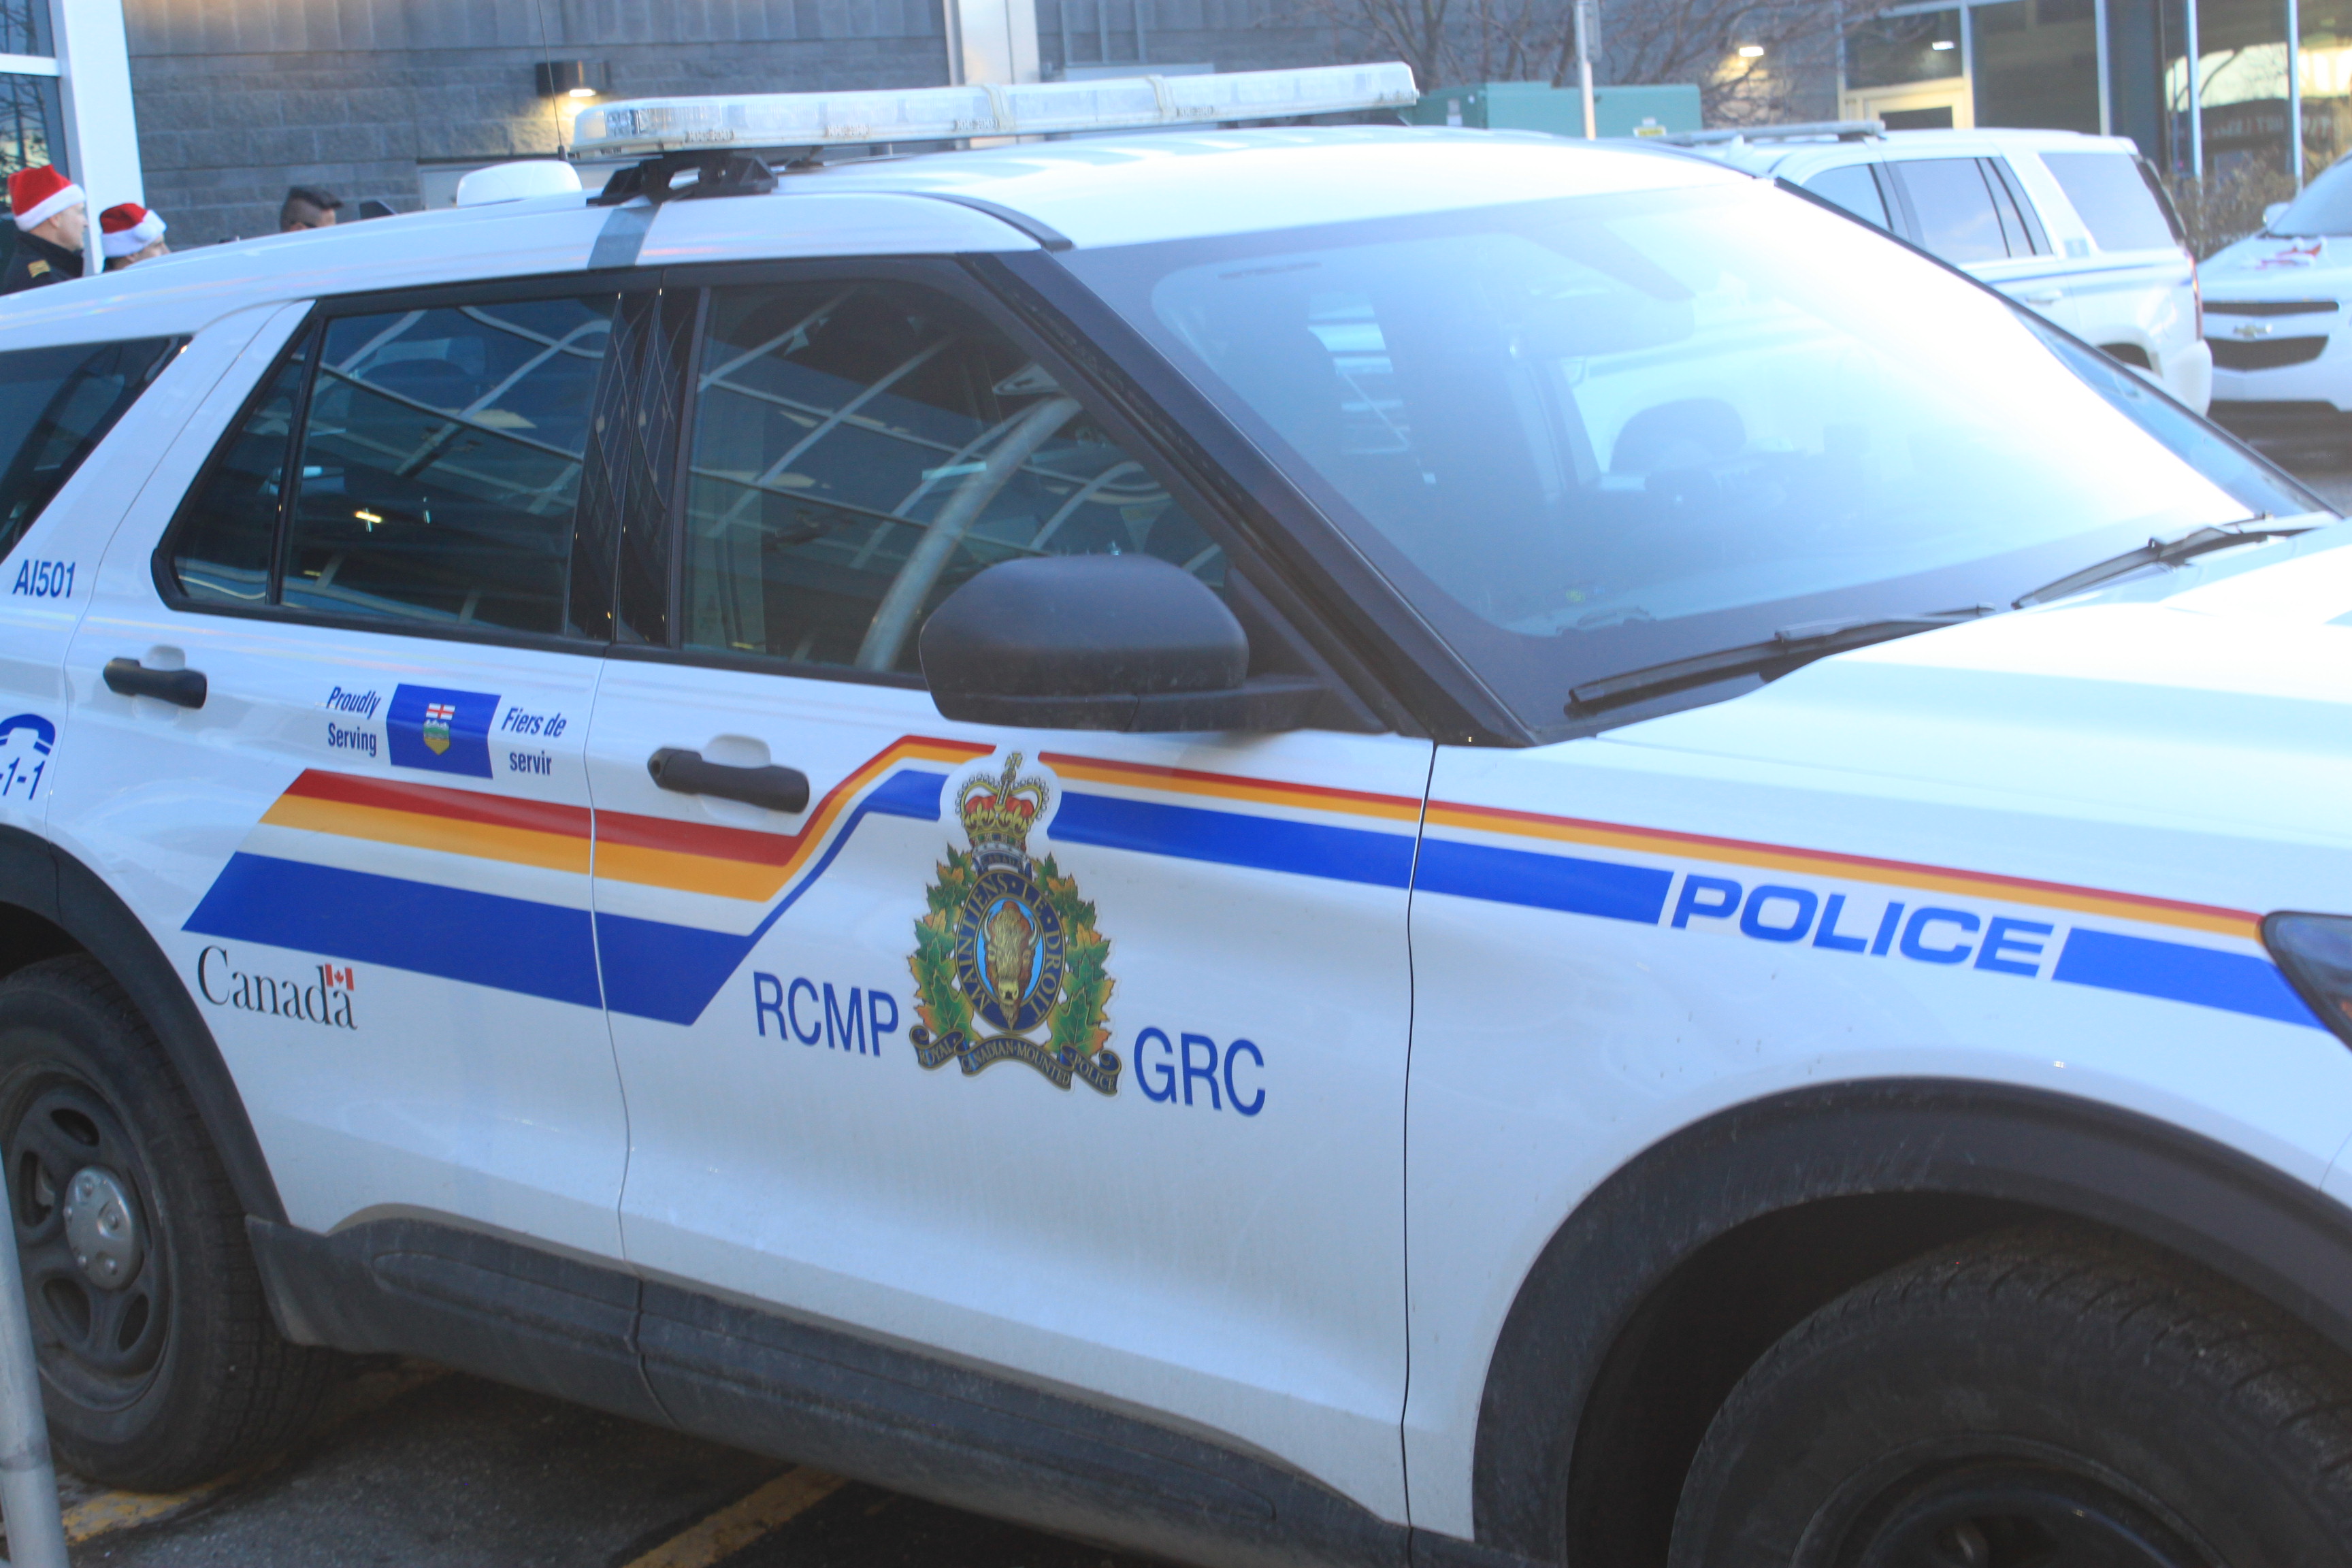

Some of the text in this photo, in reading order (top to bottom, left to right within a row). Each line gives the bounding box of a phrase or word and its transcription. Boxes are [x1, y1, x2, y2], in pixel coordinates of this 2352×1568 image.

[12, 559, 76, 598] AI501
[327, 686, 381, 720] Proudly
[501, 706, 568, 738] Fiers de
[328, 722, 377, 757] Serving
[509, 751, 552, 776] servir
[958, 873, 1062, 1022] MAINTIENS LE DROIT
[1671, 873, 2054, 978] POLICE
[197, 945, 358, 1030] Canada
[753, 970, 899, 1058] RCMP
[1017, 1043, 1071, 1086] MOUNTED
[1074, 1054, 1115, 1090] POLICE
[1134, 1026, 1266, 1117] GRC
